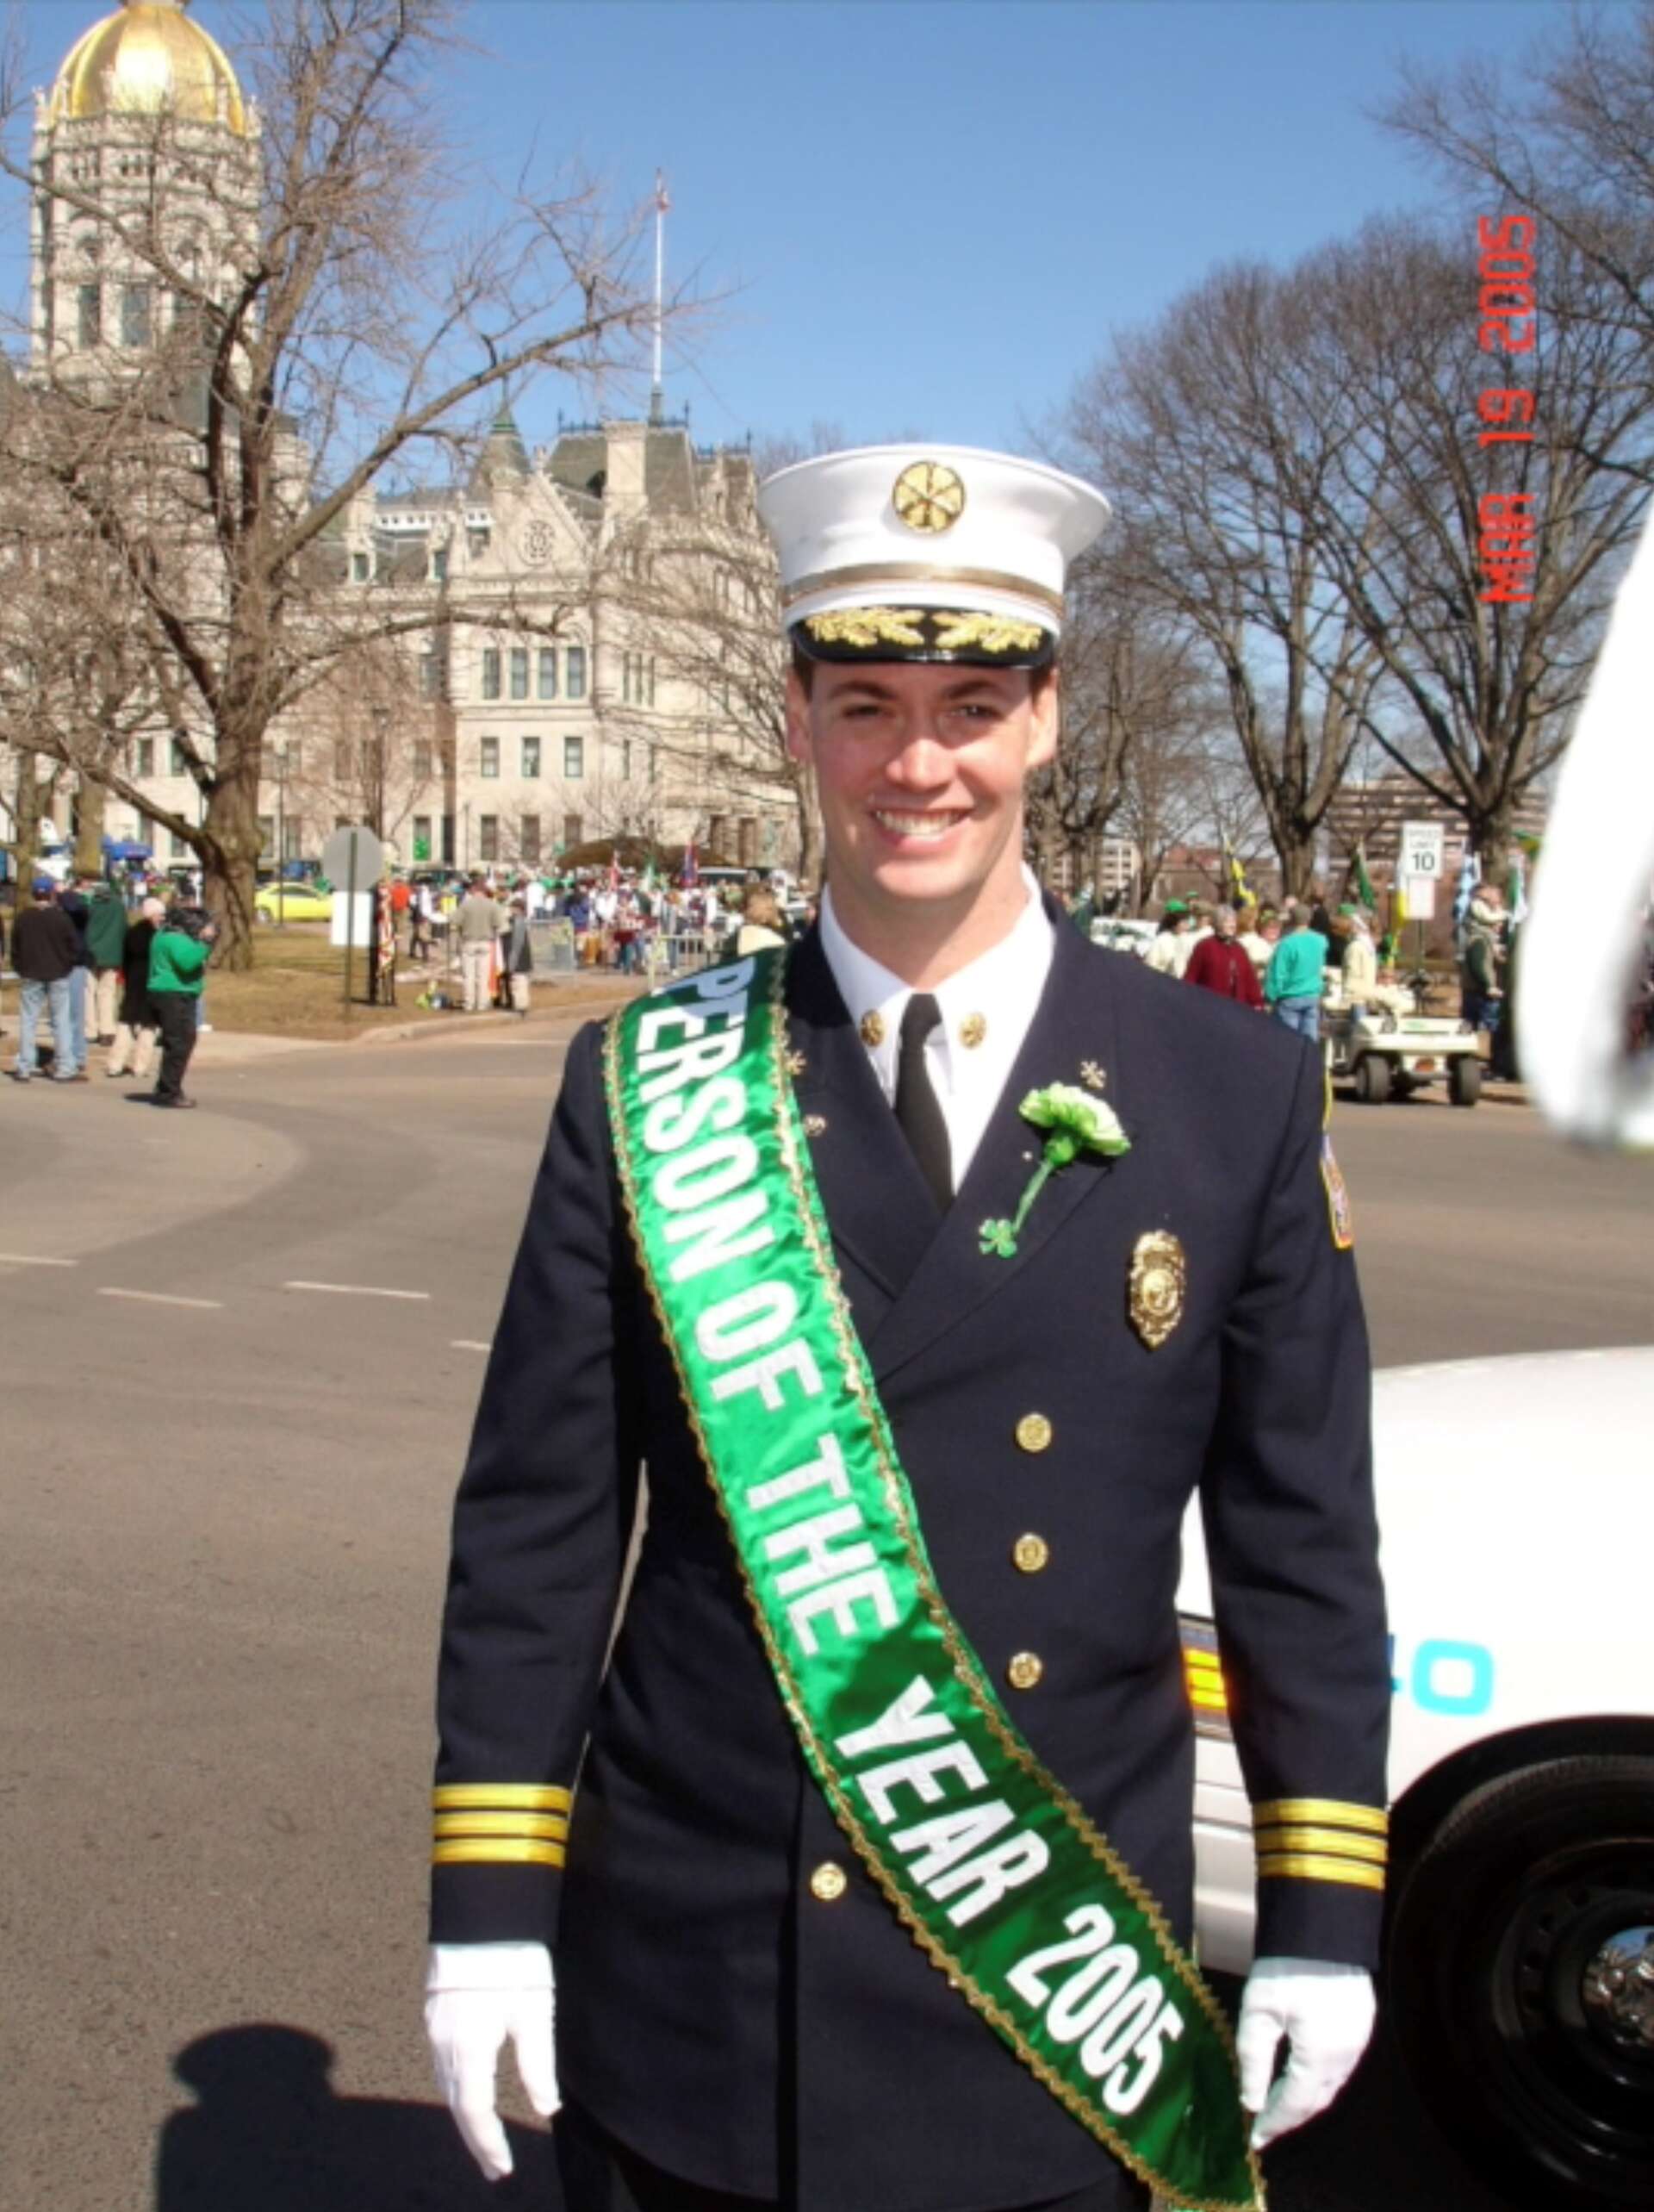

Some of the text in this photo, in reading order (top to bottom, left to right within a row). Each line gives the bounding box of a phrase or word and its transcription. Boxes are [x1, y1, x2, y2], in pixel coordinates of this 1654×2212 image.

[1412, 851, 1435, 871] 10
[637, 956, 1185, 2117] PERSON OF THE YEAR 2005
